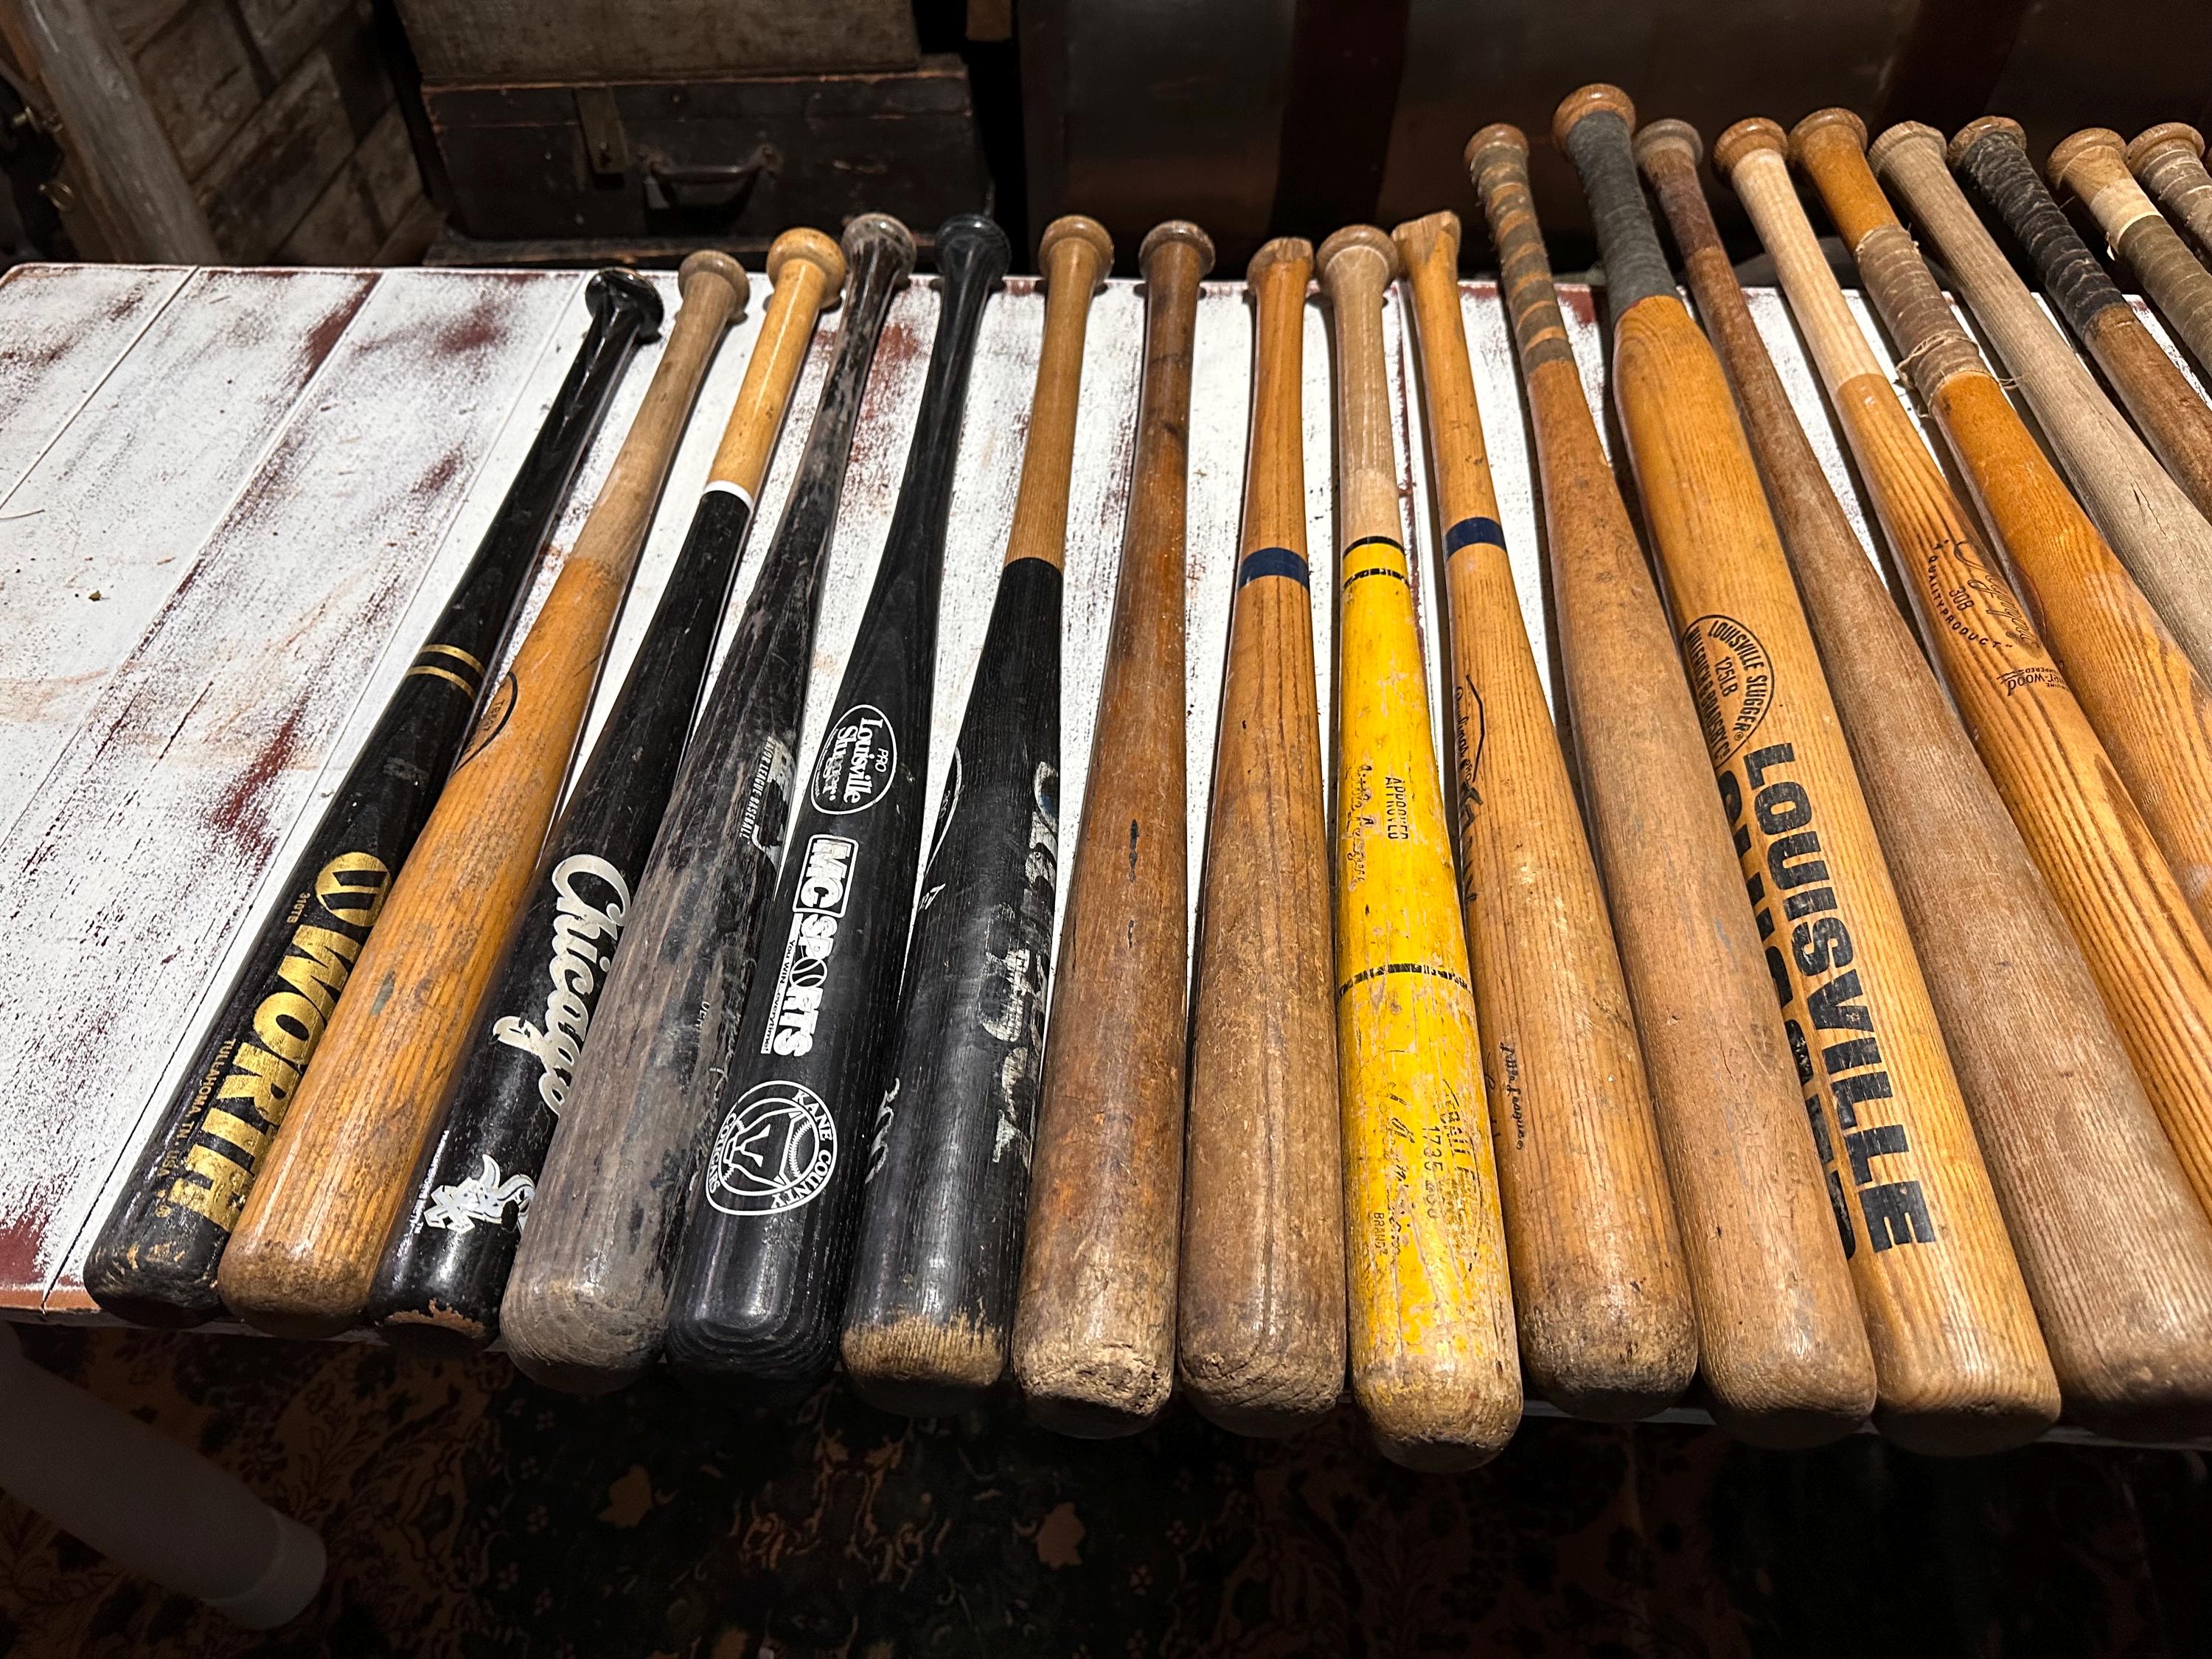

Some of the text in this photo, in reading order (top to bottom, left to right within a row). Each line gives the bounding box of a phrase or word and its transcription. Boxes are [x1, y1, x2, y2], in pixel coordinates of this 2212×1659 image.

[1927, 555, 1944, 607] QUALITY
[1940, 609, 2001, 647] PRODUCT
[1948, 585, 1974, 611] 30B
[1707, 620, 1764, 672] LOUISVILLE
[1714, 655, 1738, 698] 125LB
[751, 763, 768, 796] LEAGUE
[822, 726, 856, 793] Slugger
[843, 718, 883, 804] Louisville
[875, 748, 887, 773] PRO
[739, 796, 759, 839] BASEBALL
[1385, 777, 1408, 839] APPROVED
[773, 840, 851, 1057] MC SPORTS
[785, 940, 795, 958] You
[492, 854, 630, 1116] Chicago
[1743, 742, 1935, 1253] LOUISVILLE
[166, 925, 363, 1232] WORTH
[183, 1038, 237, 1120] TULLAHOMA,
[710, 1113, 736, 1194] COUGARS
[771, 1090, 833, 1208] KANE COUNTY
[1422, 1125, 1442, 1171] 1735
